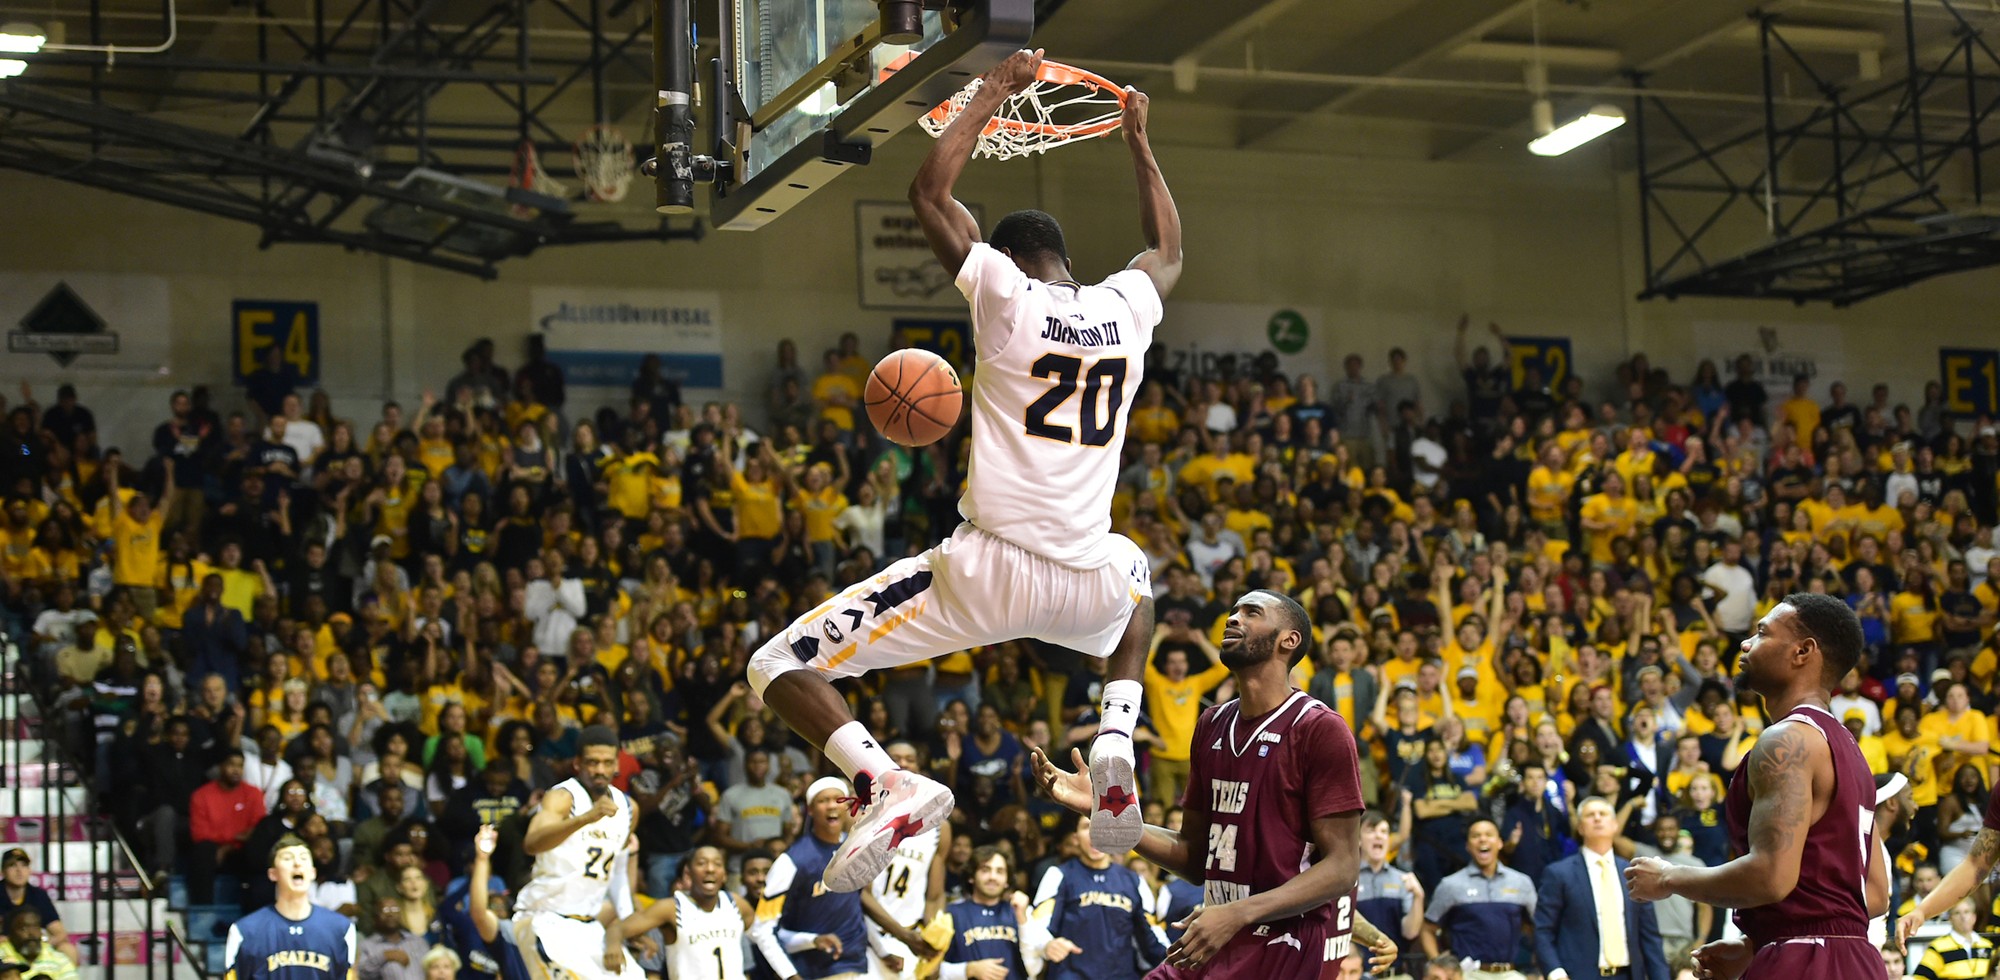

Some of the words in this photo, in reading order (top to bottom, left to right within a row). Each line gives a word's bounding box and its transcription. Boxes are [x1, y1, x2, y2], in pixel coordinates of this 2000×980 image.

[238, 309, 311, 377] E4
[1041, 316, 1103, 347] JOHNON
[1102, 321, 1121, 346] III
[1024, 351, 1129, 448] 20
[1946, 355, 1998, 414] E1
[1205, 823, 1239, 873] 24
[882, 863, 911, 898] 14
[267, 950, 331, 972] LASALLE
[712, 946, 724, 980] 1
